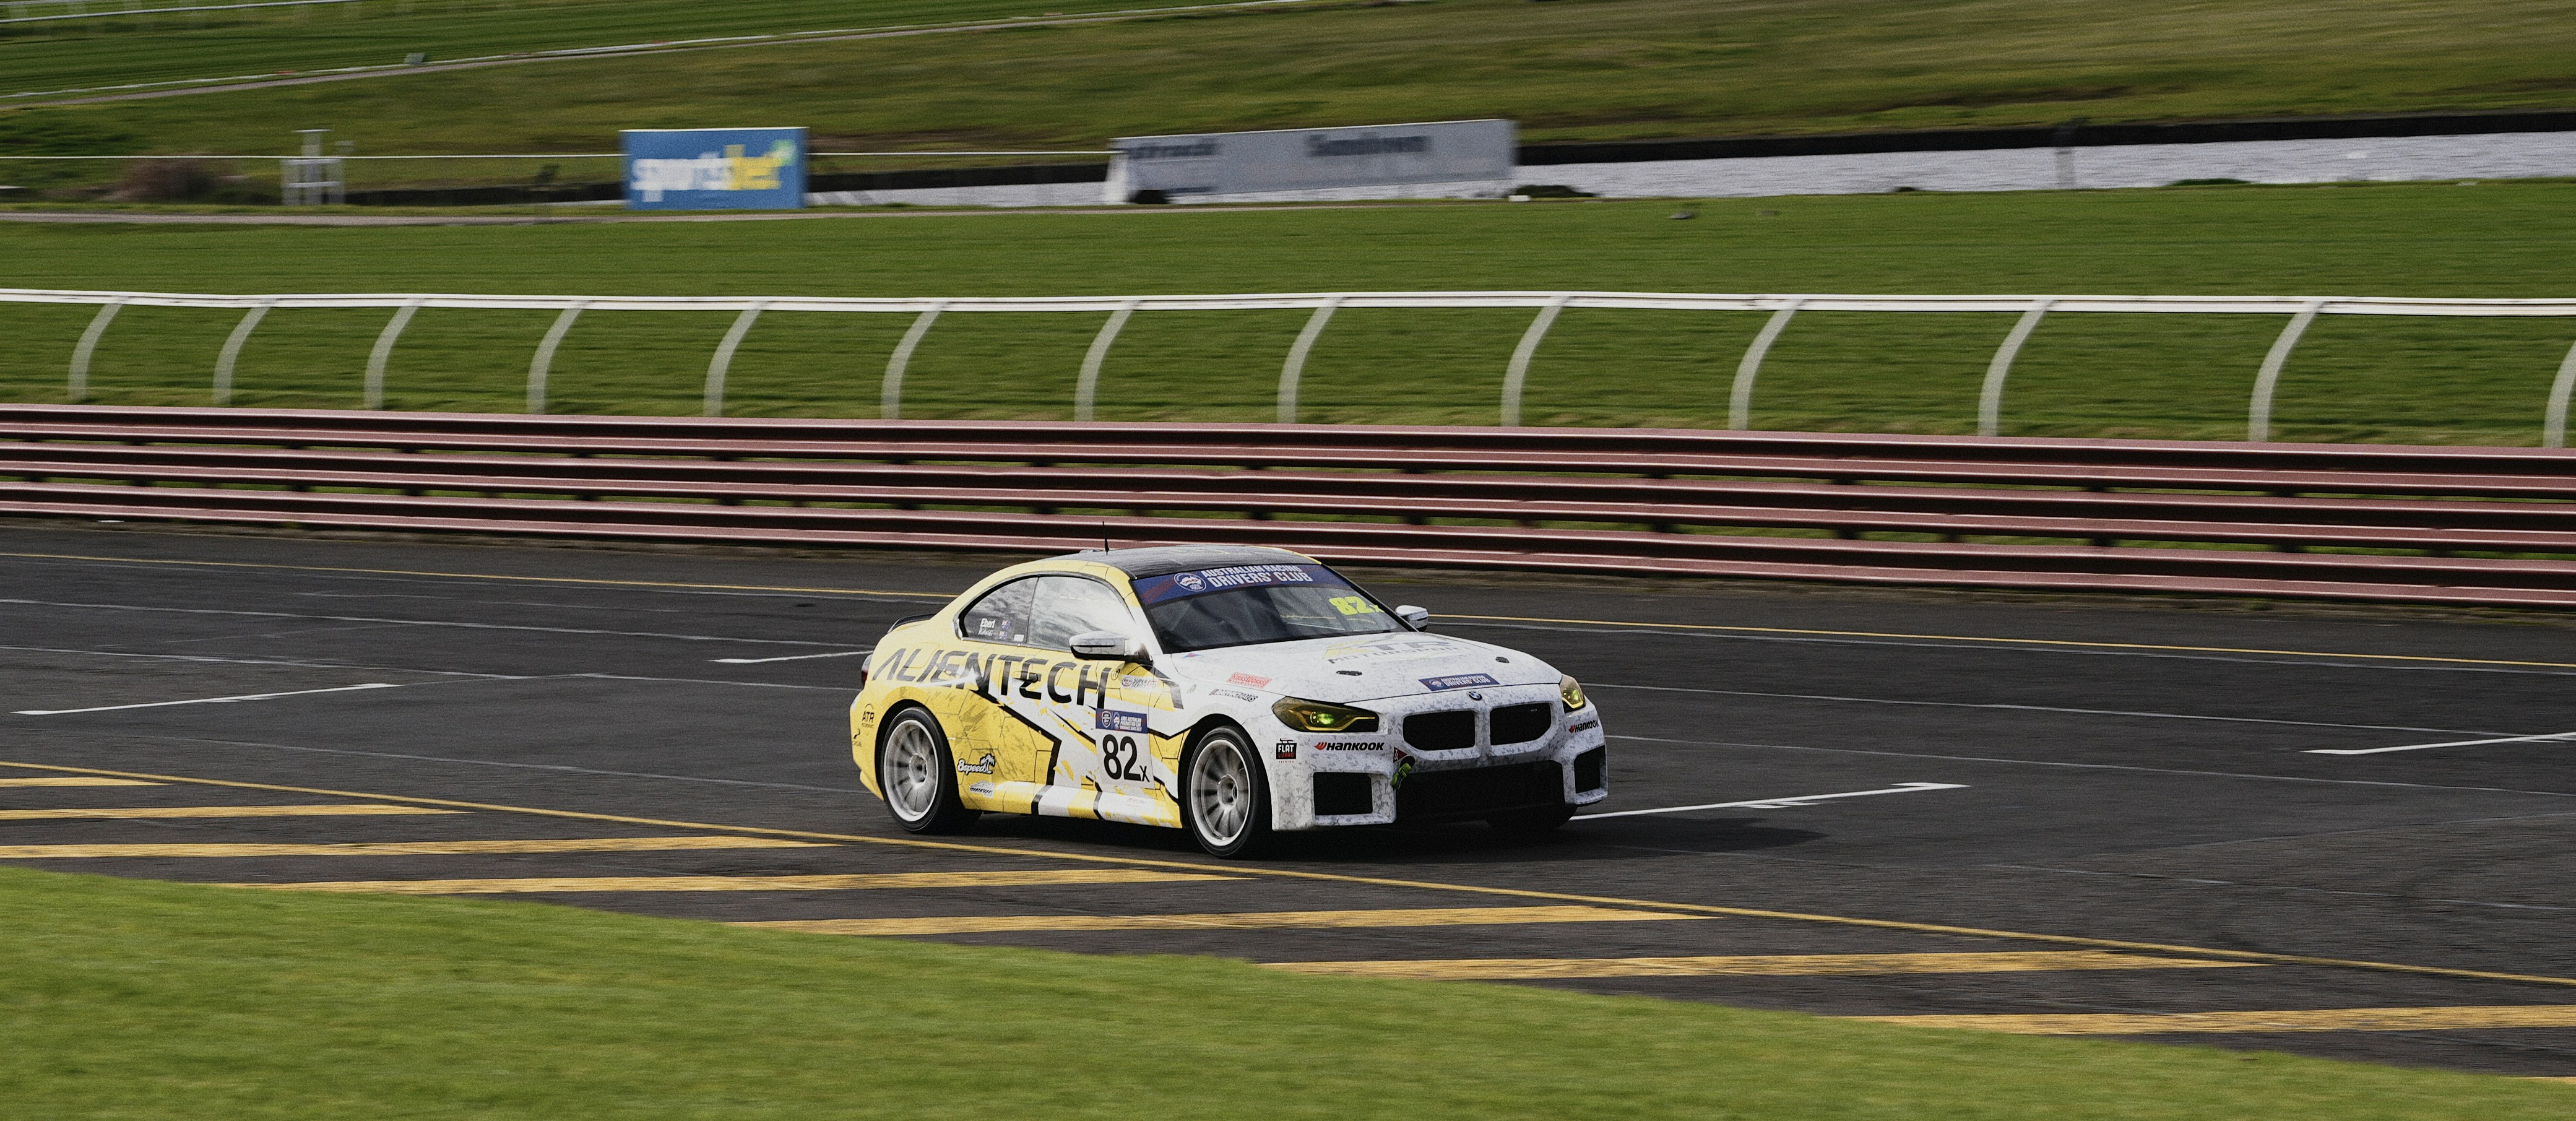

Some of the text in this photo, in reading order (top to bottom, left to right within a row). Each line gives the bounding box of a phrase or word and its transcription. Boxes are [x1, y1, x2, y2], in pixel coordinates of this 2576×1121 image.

[1201, 565, 1303, 578] AUSTRALIAN RACING
[1207, 571, 1313, 587] DRIVERS' CLUB
[873, 647, 1112, 710] ALIENTECH
[862, 711, 875, 723] ATR
[1278, 744, 1294, 753] FLAT
